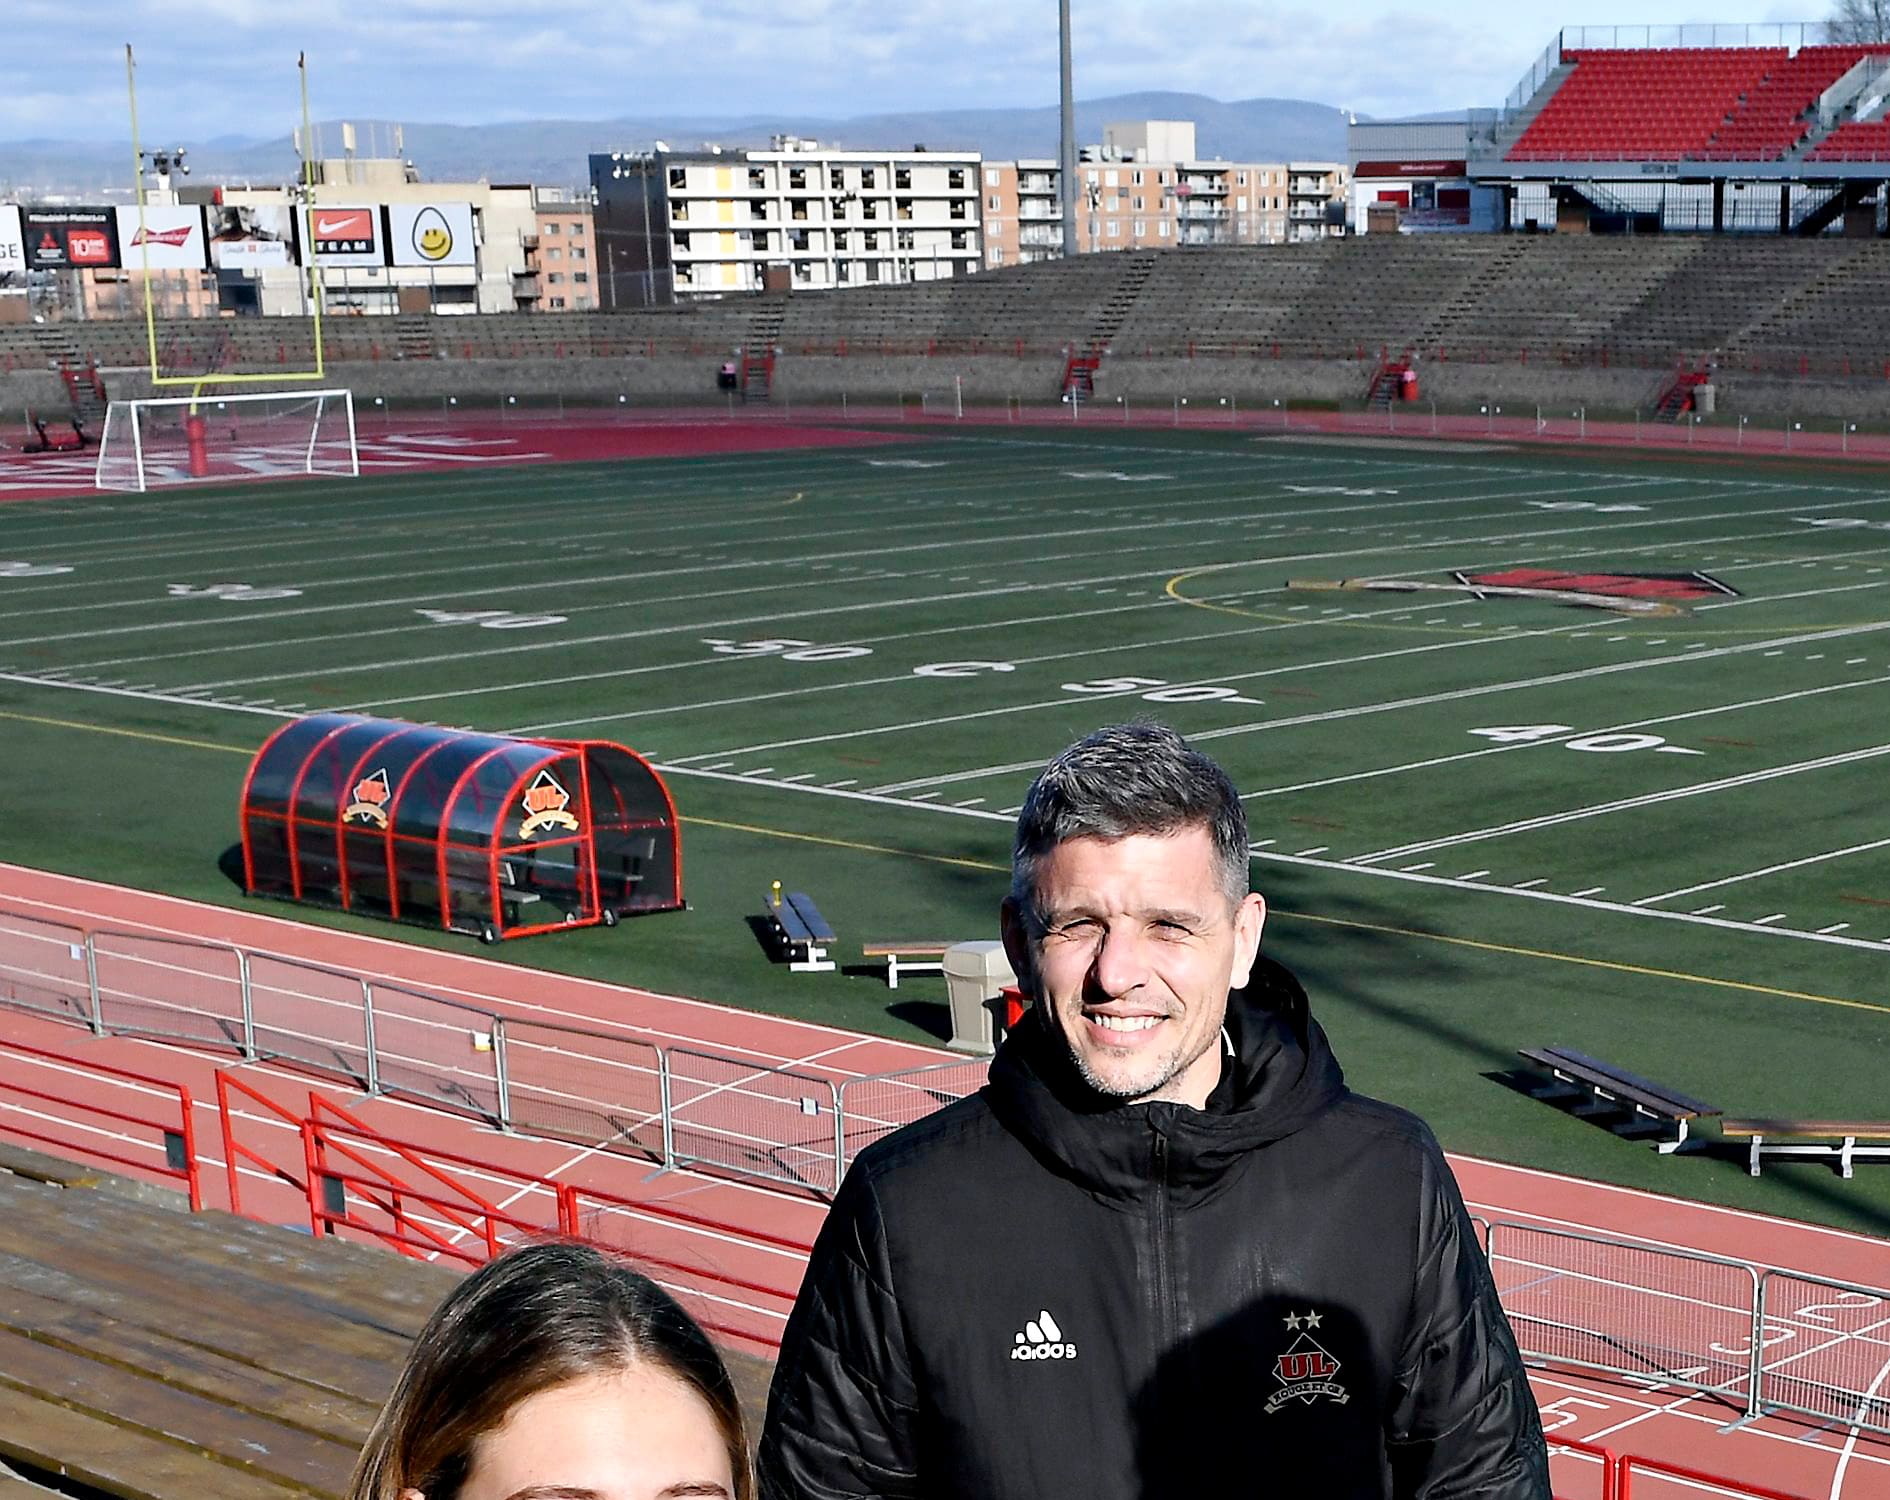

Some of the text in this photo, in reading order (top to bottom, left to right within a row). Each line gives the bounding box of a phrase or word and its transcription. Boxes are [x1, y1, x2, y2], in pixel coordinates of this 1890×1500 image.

[70, 239, 89, 257] 10
[315, 240, 368, 252] TEAM
[1277, 1351, 1336, 1381] UL
